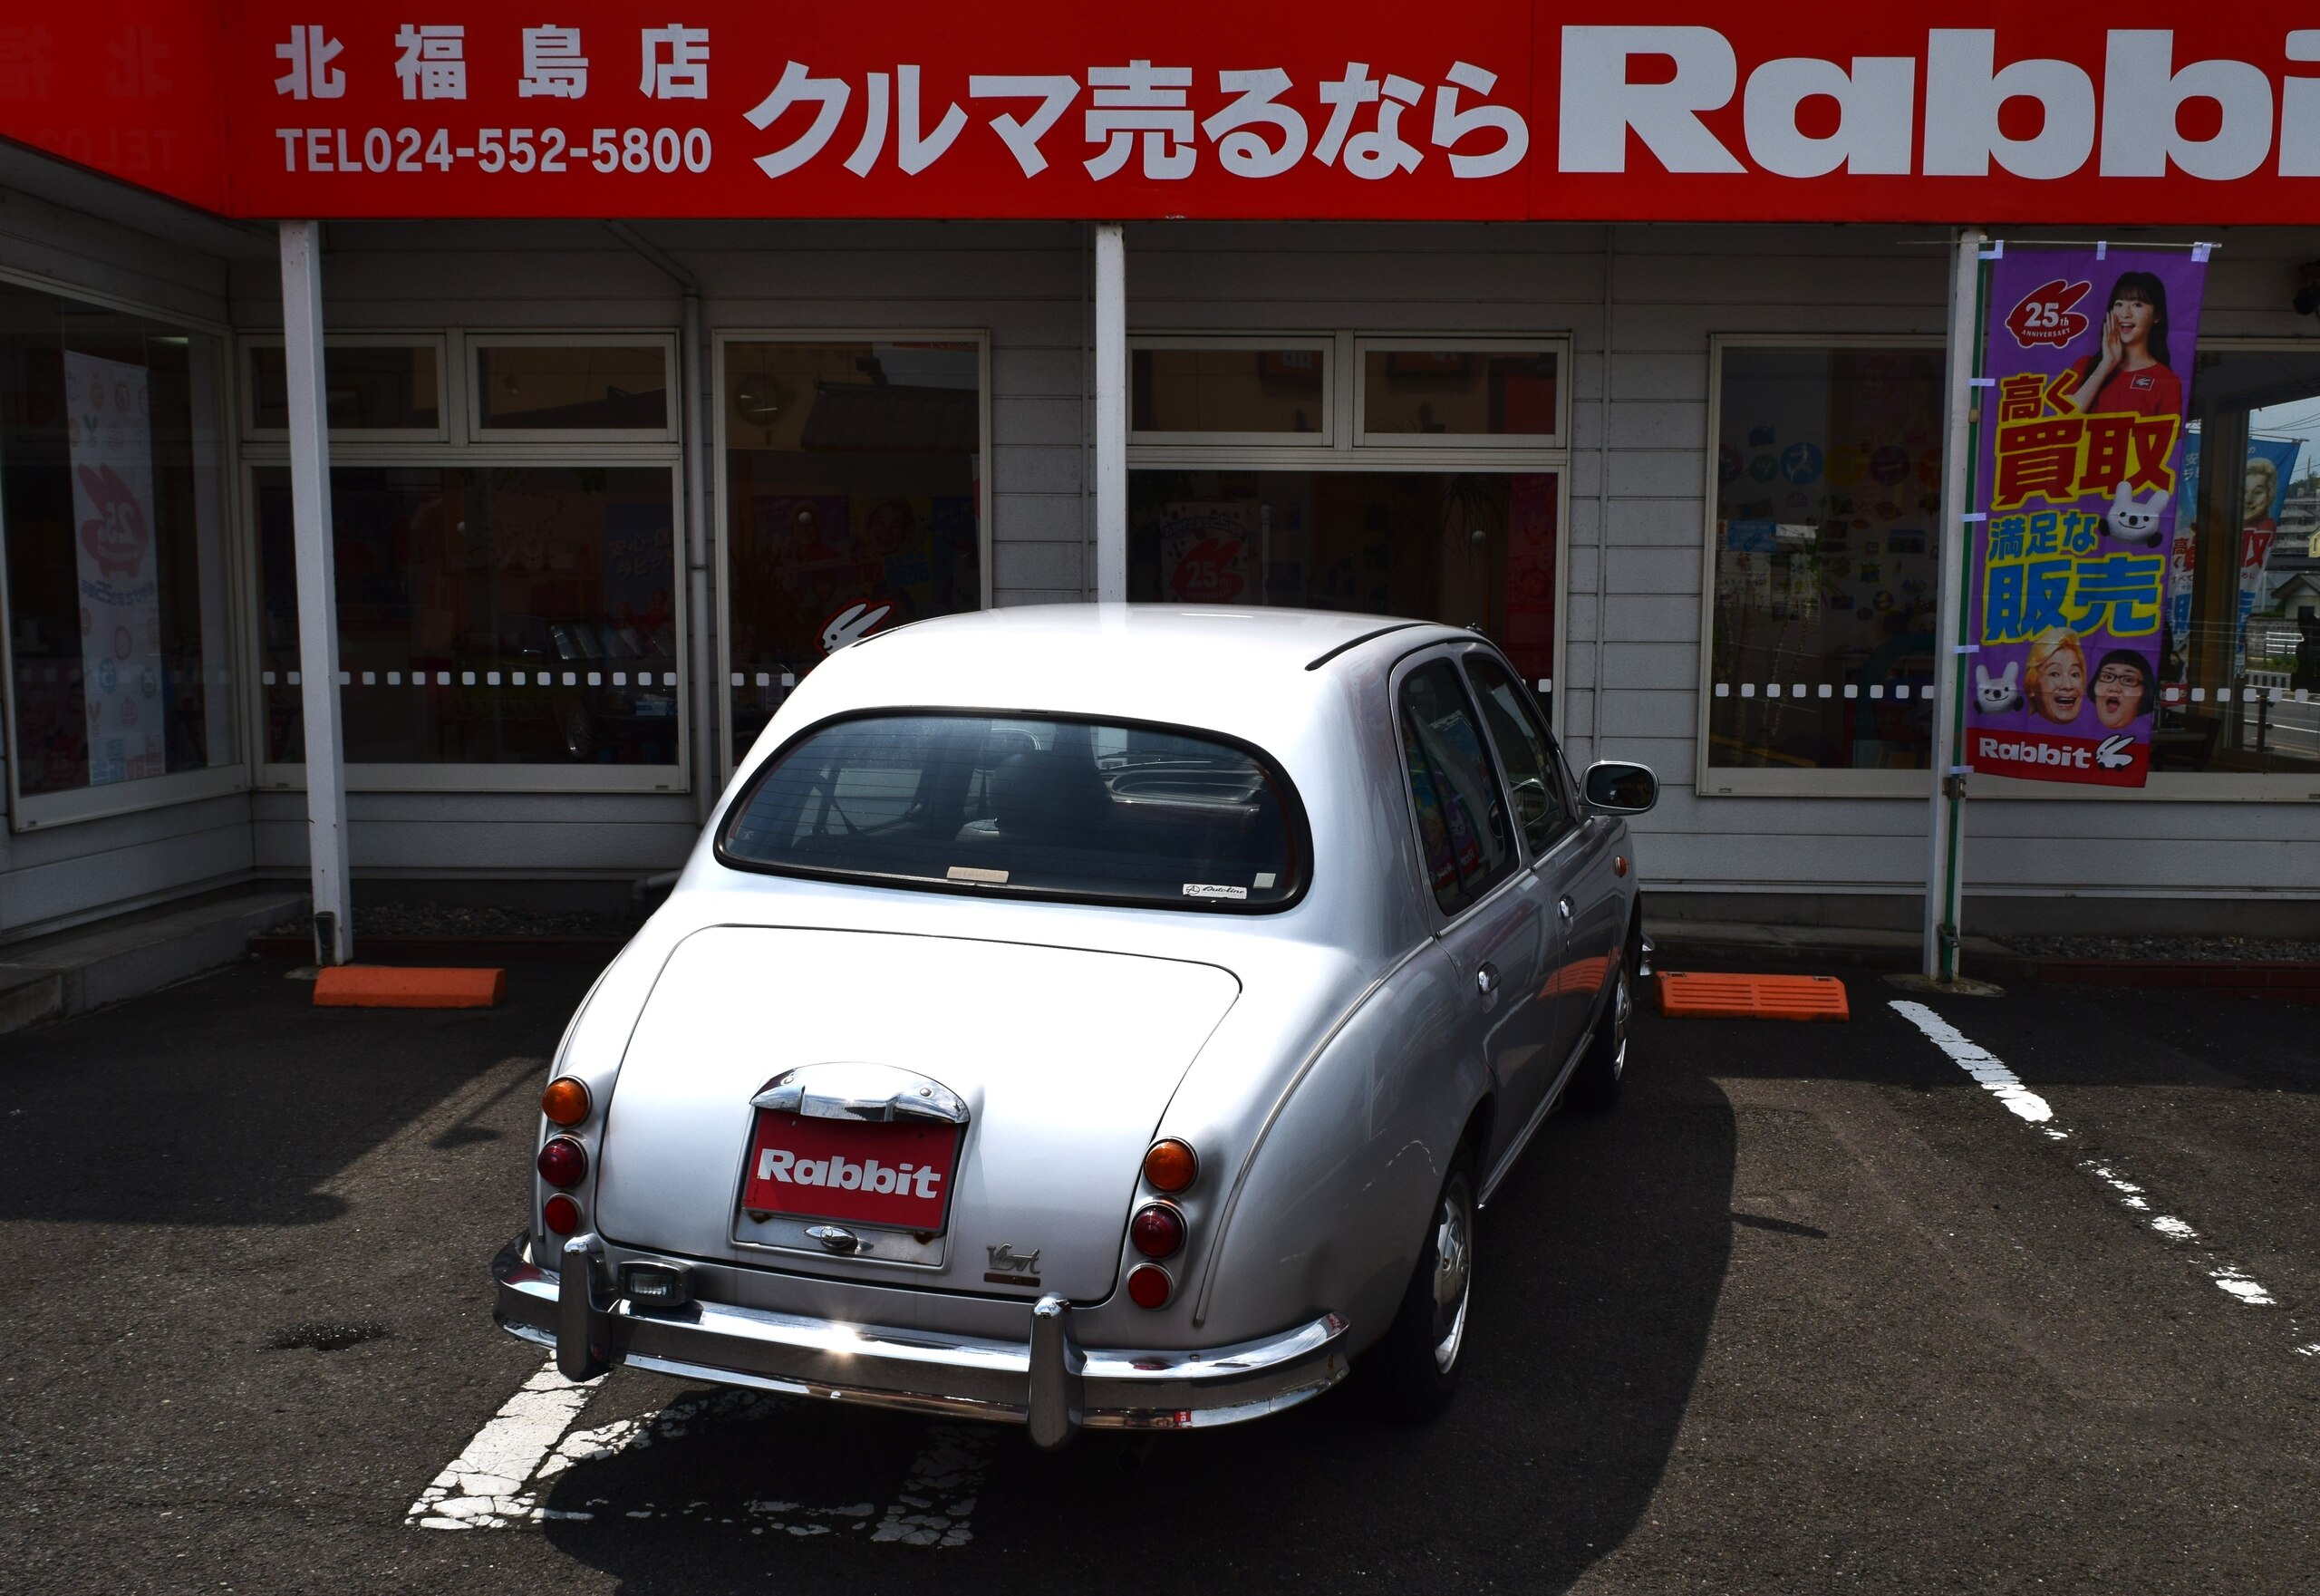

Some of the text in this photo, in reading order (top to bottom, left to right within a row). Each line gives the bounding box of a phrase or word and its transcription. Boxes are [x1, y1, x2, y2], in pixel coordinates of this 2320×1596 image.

[276, 24, 710, 100] 北福島店
[743, 60, 1529, 180] クルマ売るなら
[276, 127, 712, 173] TEL024-552-5800
[2021, 327, 2071, 338] ANNIVERSARY
[2000, 369, 2078, 422] 高く
[1994, 413, 2178, 508] 買取
[1988, 510, 2099, 561] 満足な
[1984, 556, 2162, 643] 販売
[1979, 738, 2092, 769] Rabbit
[758, 1148, 942, 1199] Rabbit
